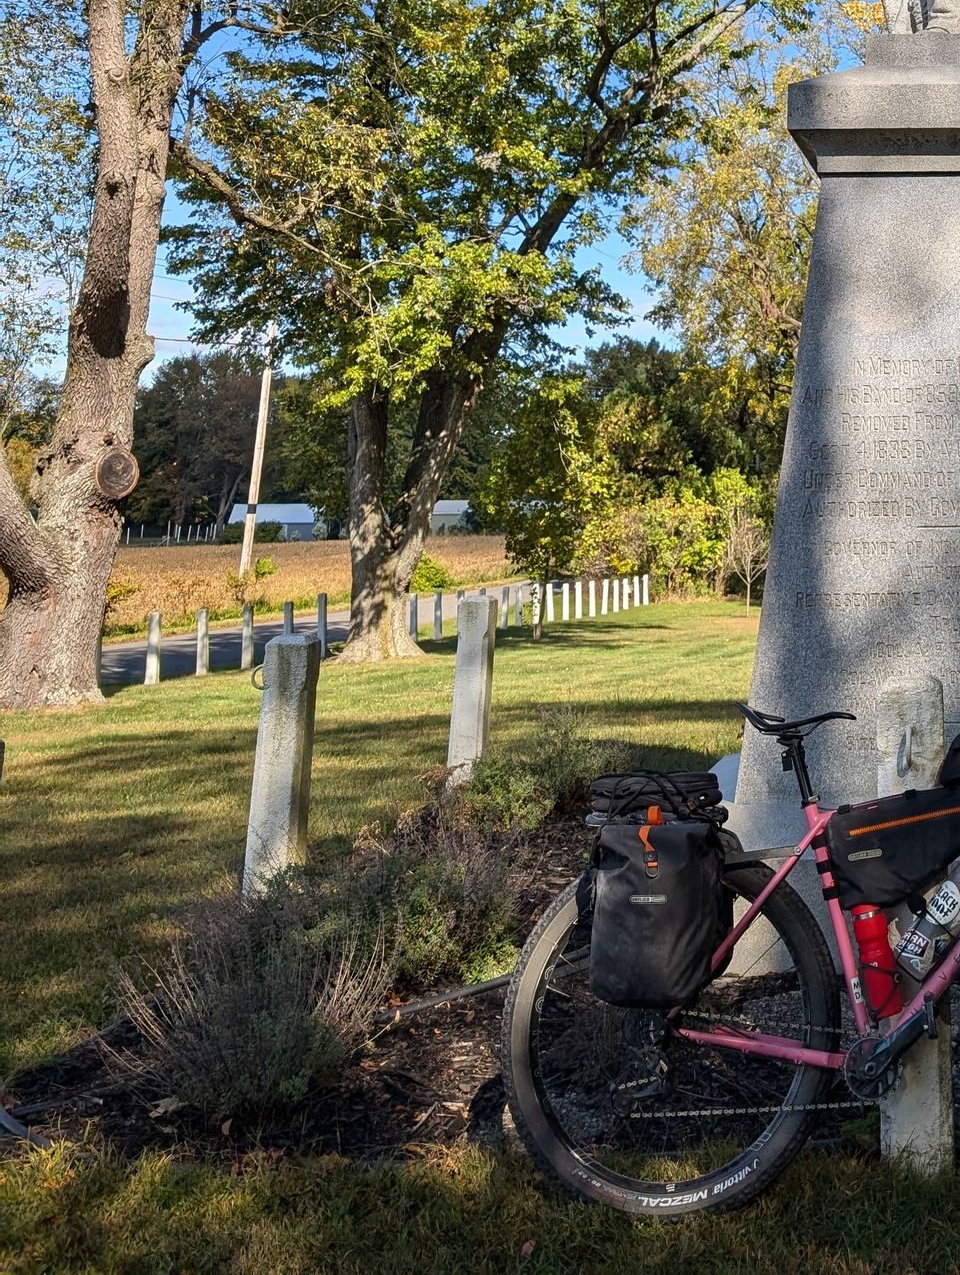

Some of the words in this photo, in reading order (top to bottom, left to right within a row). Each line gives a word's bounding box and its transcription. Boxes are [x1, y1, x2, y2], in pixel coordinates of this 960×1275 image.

[868, 356, 931, 376] MEMORY
[935, 359, 954, 374] OF
[837, 385, 859, 404] HIS
[862, 384, 901, 404] BAND
[904, 387, 924, 403] OF
[841, 412, 910, 432] REMOVED
[914, 411, 954, 431] FROM
[857, 468, 931, 488] COMMAND
[935, 470, 955, 487] OF
[802, 498, 899, 518] AUTHORIZED
[823, 540, 898, 556] GOVERNOR
[906, 540, 923, 556] OF
[796, 591, 921, 609] REPRESENTATIVE
[712, 1166, 752, 1195] vittoria
[638, 1191, 708, 1207] MEZCAL
